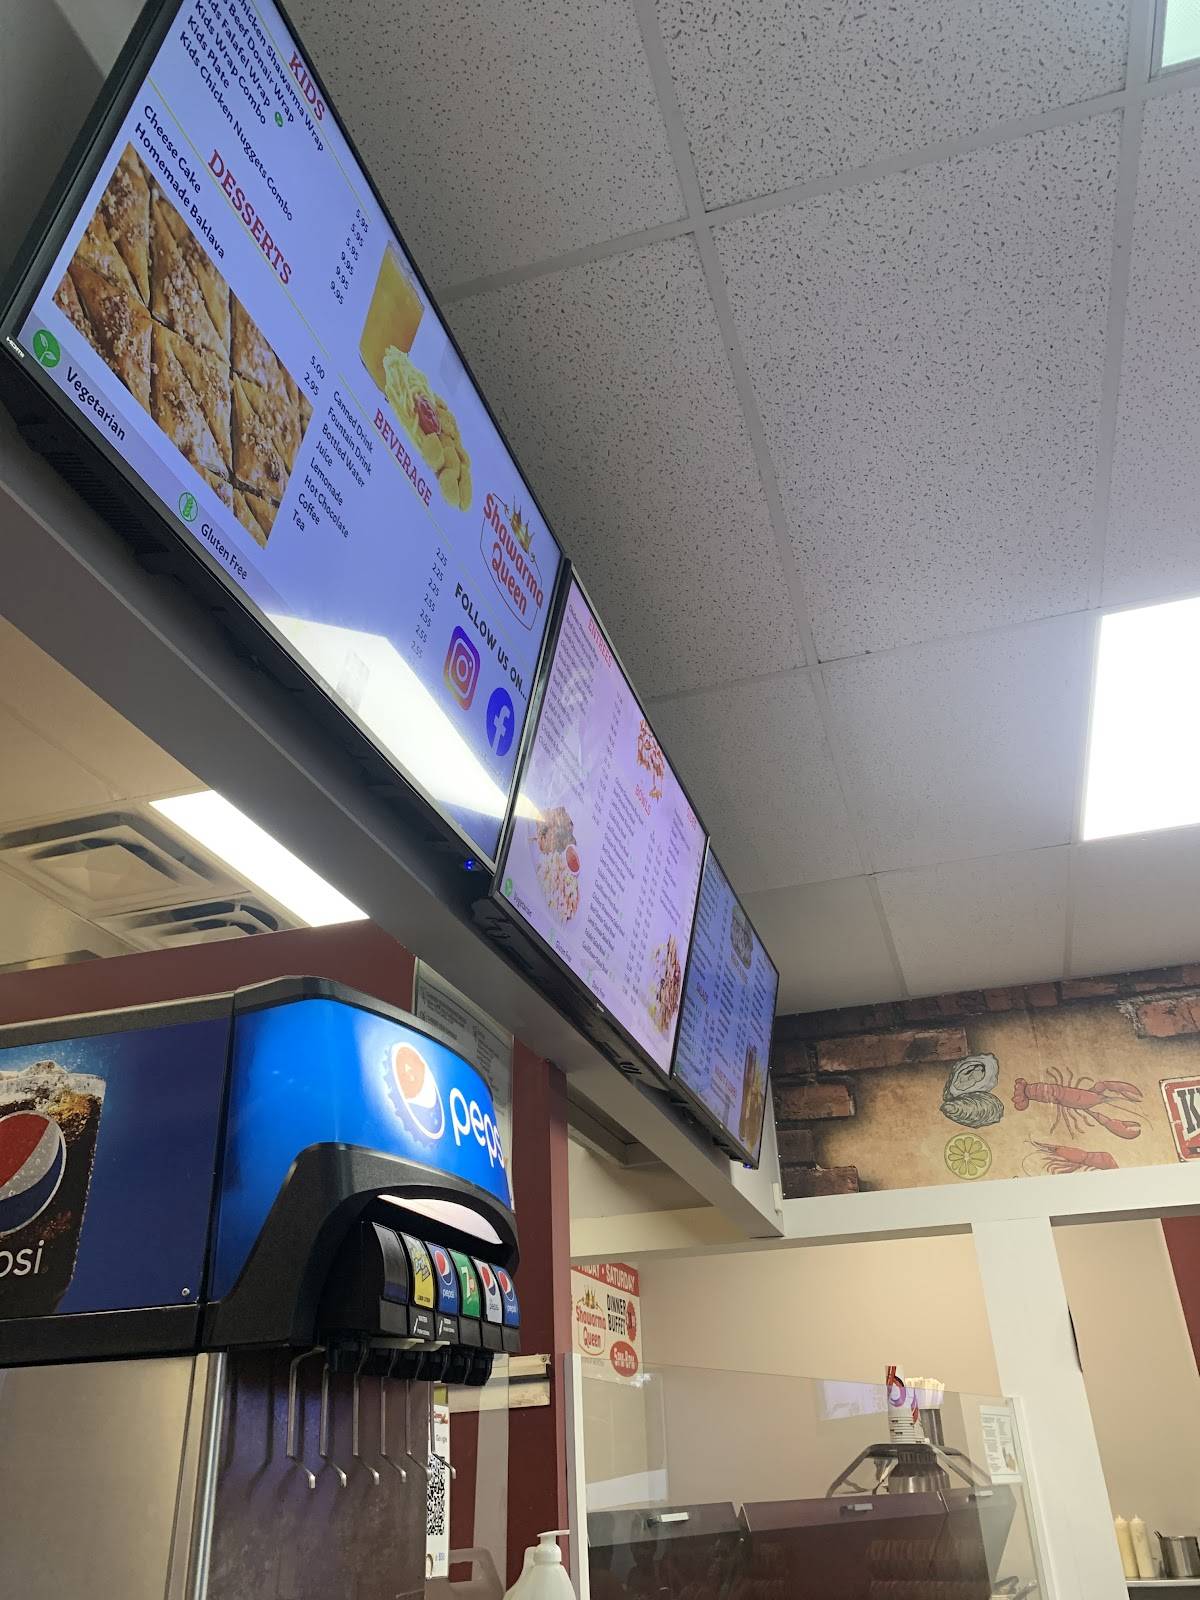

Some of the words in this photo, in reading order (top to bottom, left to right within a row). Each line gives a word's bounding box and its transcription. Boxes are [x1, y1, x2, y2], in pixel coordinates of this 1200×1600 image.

[187, 15, 207, 52] Kids
[207, 48, 230, 88] Plate
[195, 0, 215, 35] Kids
[215, 32, 238, 76] Wrap
[238, 75, 266, 125] Combo
[221, 18, 249, 68] Falafel
[249, 65, 270, 107] Wrap
[229, 3, 249, 38] Beef
[247, 36, 274, 84] Donair
[274, 82, 294, 122] Wrap
[240, 0, 266, 46] hicken
[266, 45, 304, 116] Shawarma
[305, 113, 324, 151] Wrap
[289, 51, 325, 120] KIDS
[144, 105, 178, 159] Cheese
[178, 157, 201, 194] Cake
[180, 31, 200, 67] Kids
[200, 65, 233, 123] Chicken
[233, 120, 267, 178] Nuggets
[267, 176, 292, 221] Combo
[135, 122, 190, 208] Homemade
[189, 203, 225, 259] Baklava
[207, 149, 292, 285] DESSERTS
[355, 208, 369, 233] 5.95
[340, 251, 354, 275] 9.95
[345, 238, 359, 261] 5.95
[350, 223, 364, 247] 5.95
[330, 281, 345, 305] 9.95
[335, 265, 349, 290] 9.95
[303, 372, 319, 396] 2.95
[310, 355, 325, 380] 5.00
[66, 366, 126, 441] Vegetarian
[333, 391, 357, 430] Canned
[356, 424, 374, 454] Drink
[315, 440, 333, 467] Juice
[322, 423, 347, 461] Bottled
[345, 457, 365, 488] Water
[327, 407, 355, 452] Fountain
[354, 444, 372, 476] Drink
[373, 408, 432, 507] BEVERAGE
[298, 493, 320, 525] Coffee
[304, 474, 319, 497] Hot
[318, 493, 350, 538] Chocolate
[310, 457, 344, 506] Lemonade
[201, 522, 230, 565] Gluten
[229, 553, 248, 580] Free
[291, 509, 305, 532] Tea
[483, 492, 544, 609] Shawarma
[492, 542, 528, 616] Queen
[455, 582, 497, 651] FOLLOW
[497, 646, 509, 671] US
[510, 666, 527, 701] ON...
[605, 1263, 635, 1292] SATURDAY
[607, 1293, 626, 1316] DINNER
[607, 1313, 625, 1336] BUFFET
